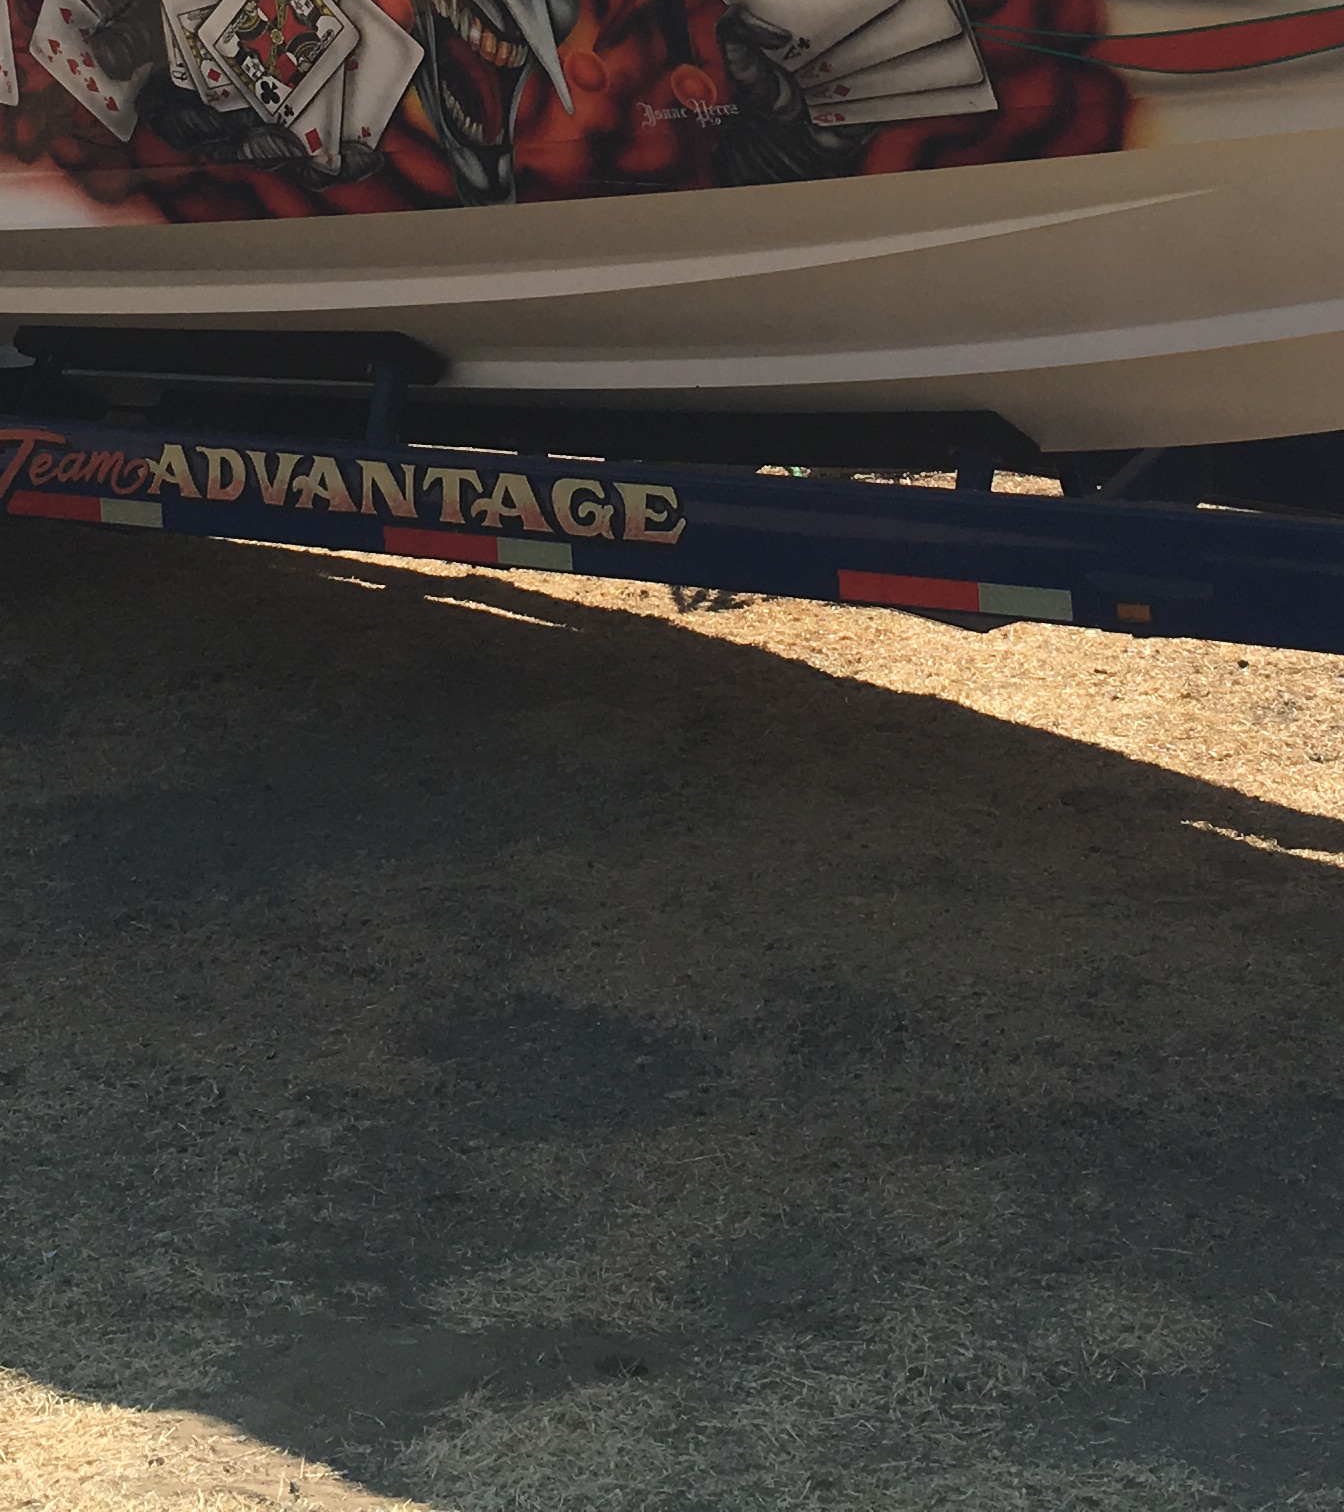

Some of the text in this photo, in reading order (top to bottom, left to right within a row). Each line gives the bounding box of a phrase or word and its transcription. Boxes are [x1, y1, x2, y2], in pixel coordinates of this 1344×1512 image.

[782, 44, 802, 60] A
[687, 98, 740, 128] Perez
[146, 441, 689, 546] ADVANTAGE
